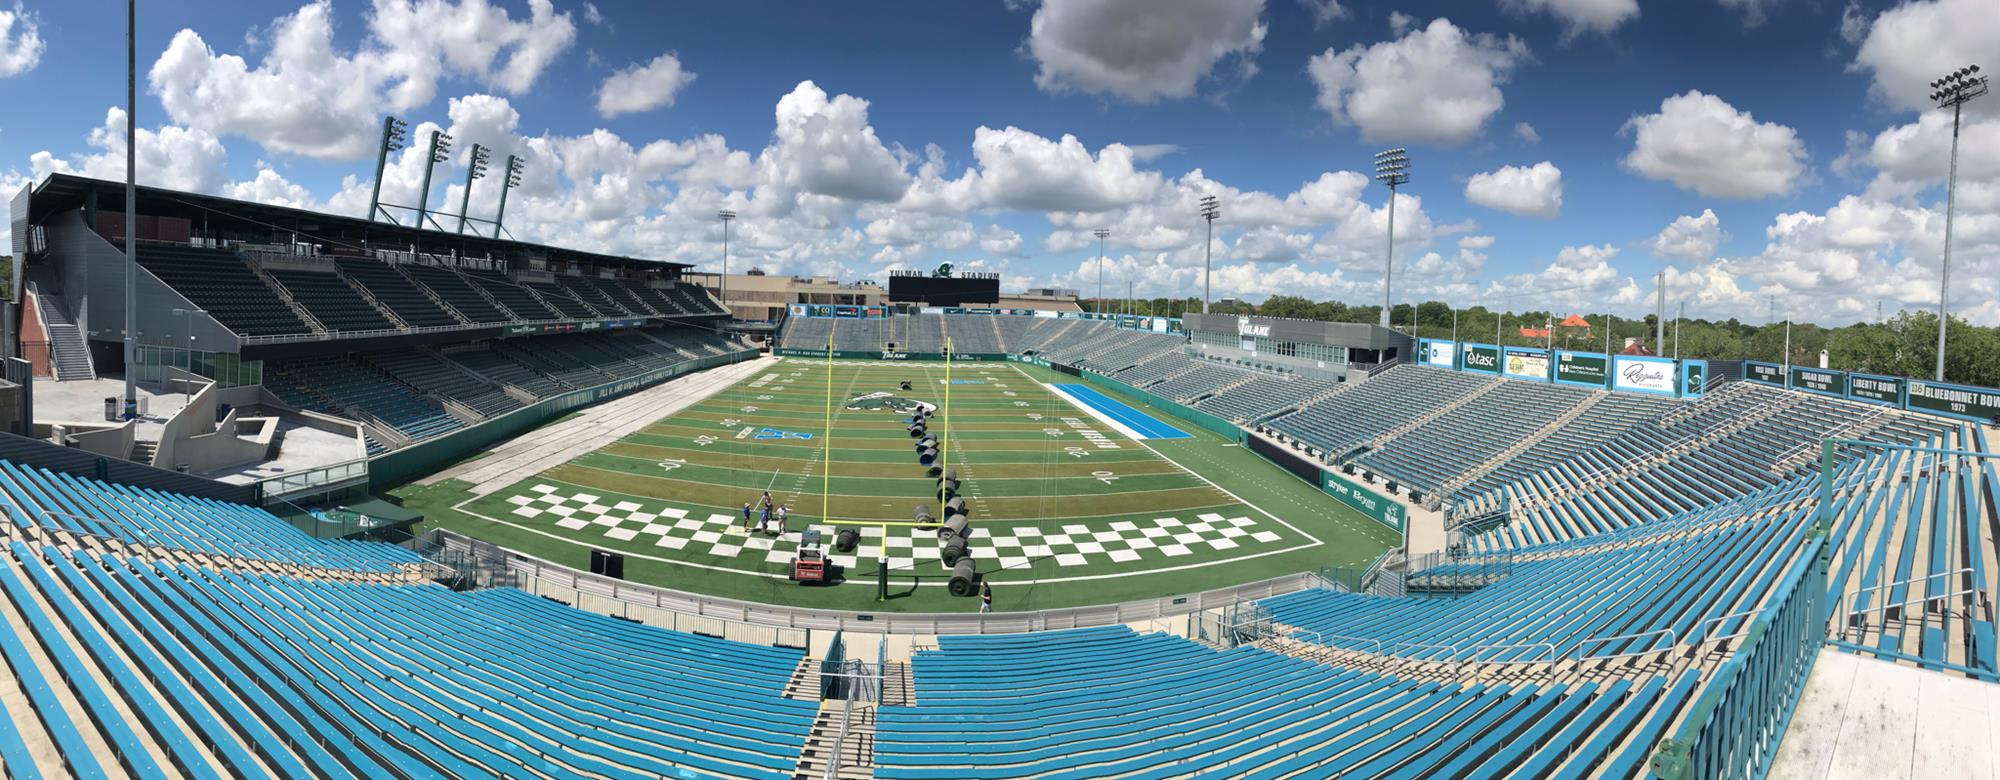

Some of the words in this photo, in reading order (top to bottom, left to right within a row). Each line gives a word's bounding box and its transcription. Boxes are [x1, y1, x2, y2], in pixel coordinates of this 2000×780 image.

[889, 269, 923, 278] YULMAN
[961, 272, 1000, 280] STADIUM
[1238, 317, 1270, 336] TULANE
[1475, 353, 1495, 366] tasc
[1801, 371, 1817, 381] SUGAR
[1818, 373, 1832, 384] BOWL
[1853, 378, 1877, 390] LIBERTY
[1878, 381, 1897, 393] BOWL
[1925, 387, 1978, 405] BLUEBONNET
[1950, 402, 1966, 412] 1973
